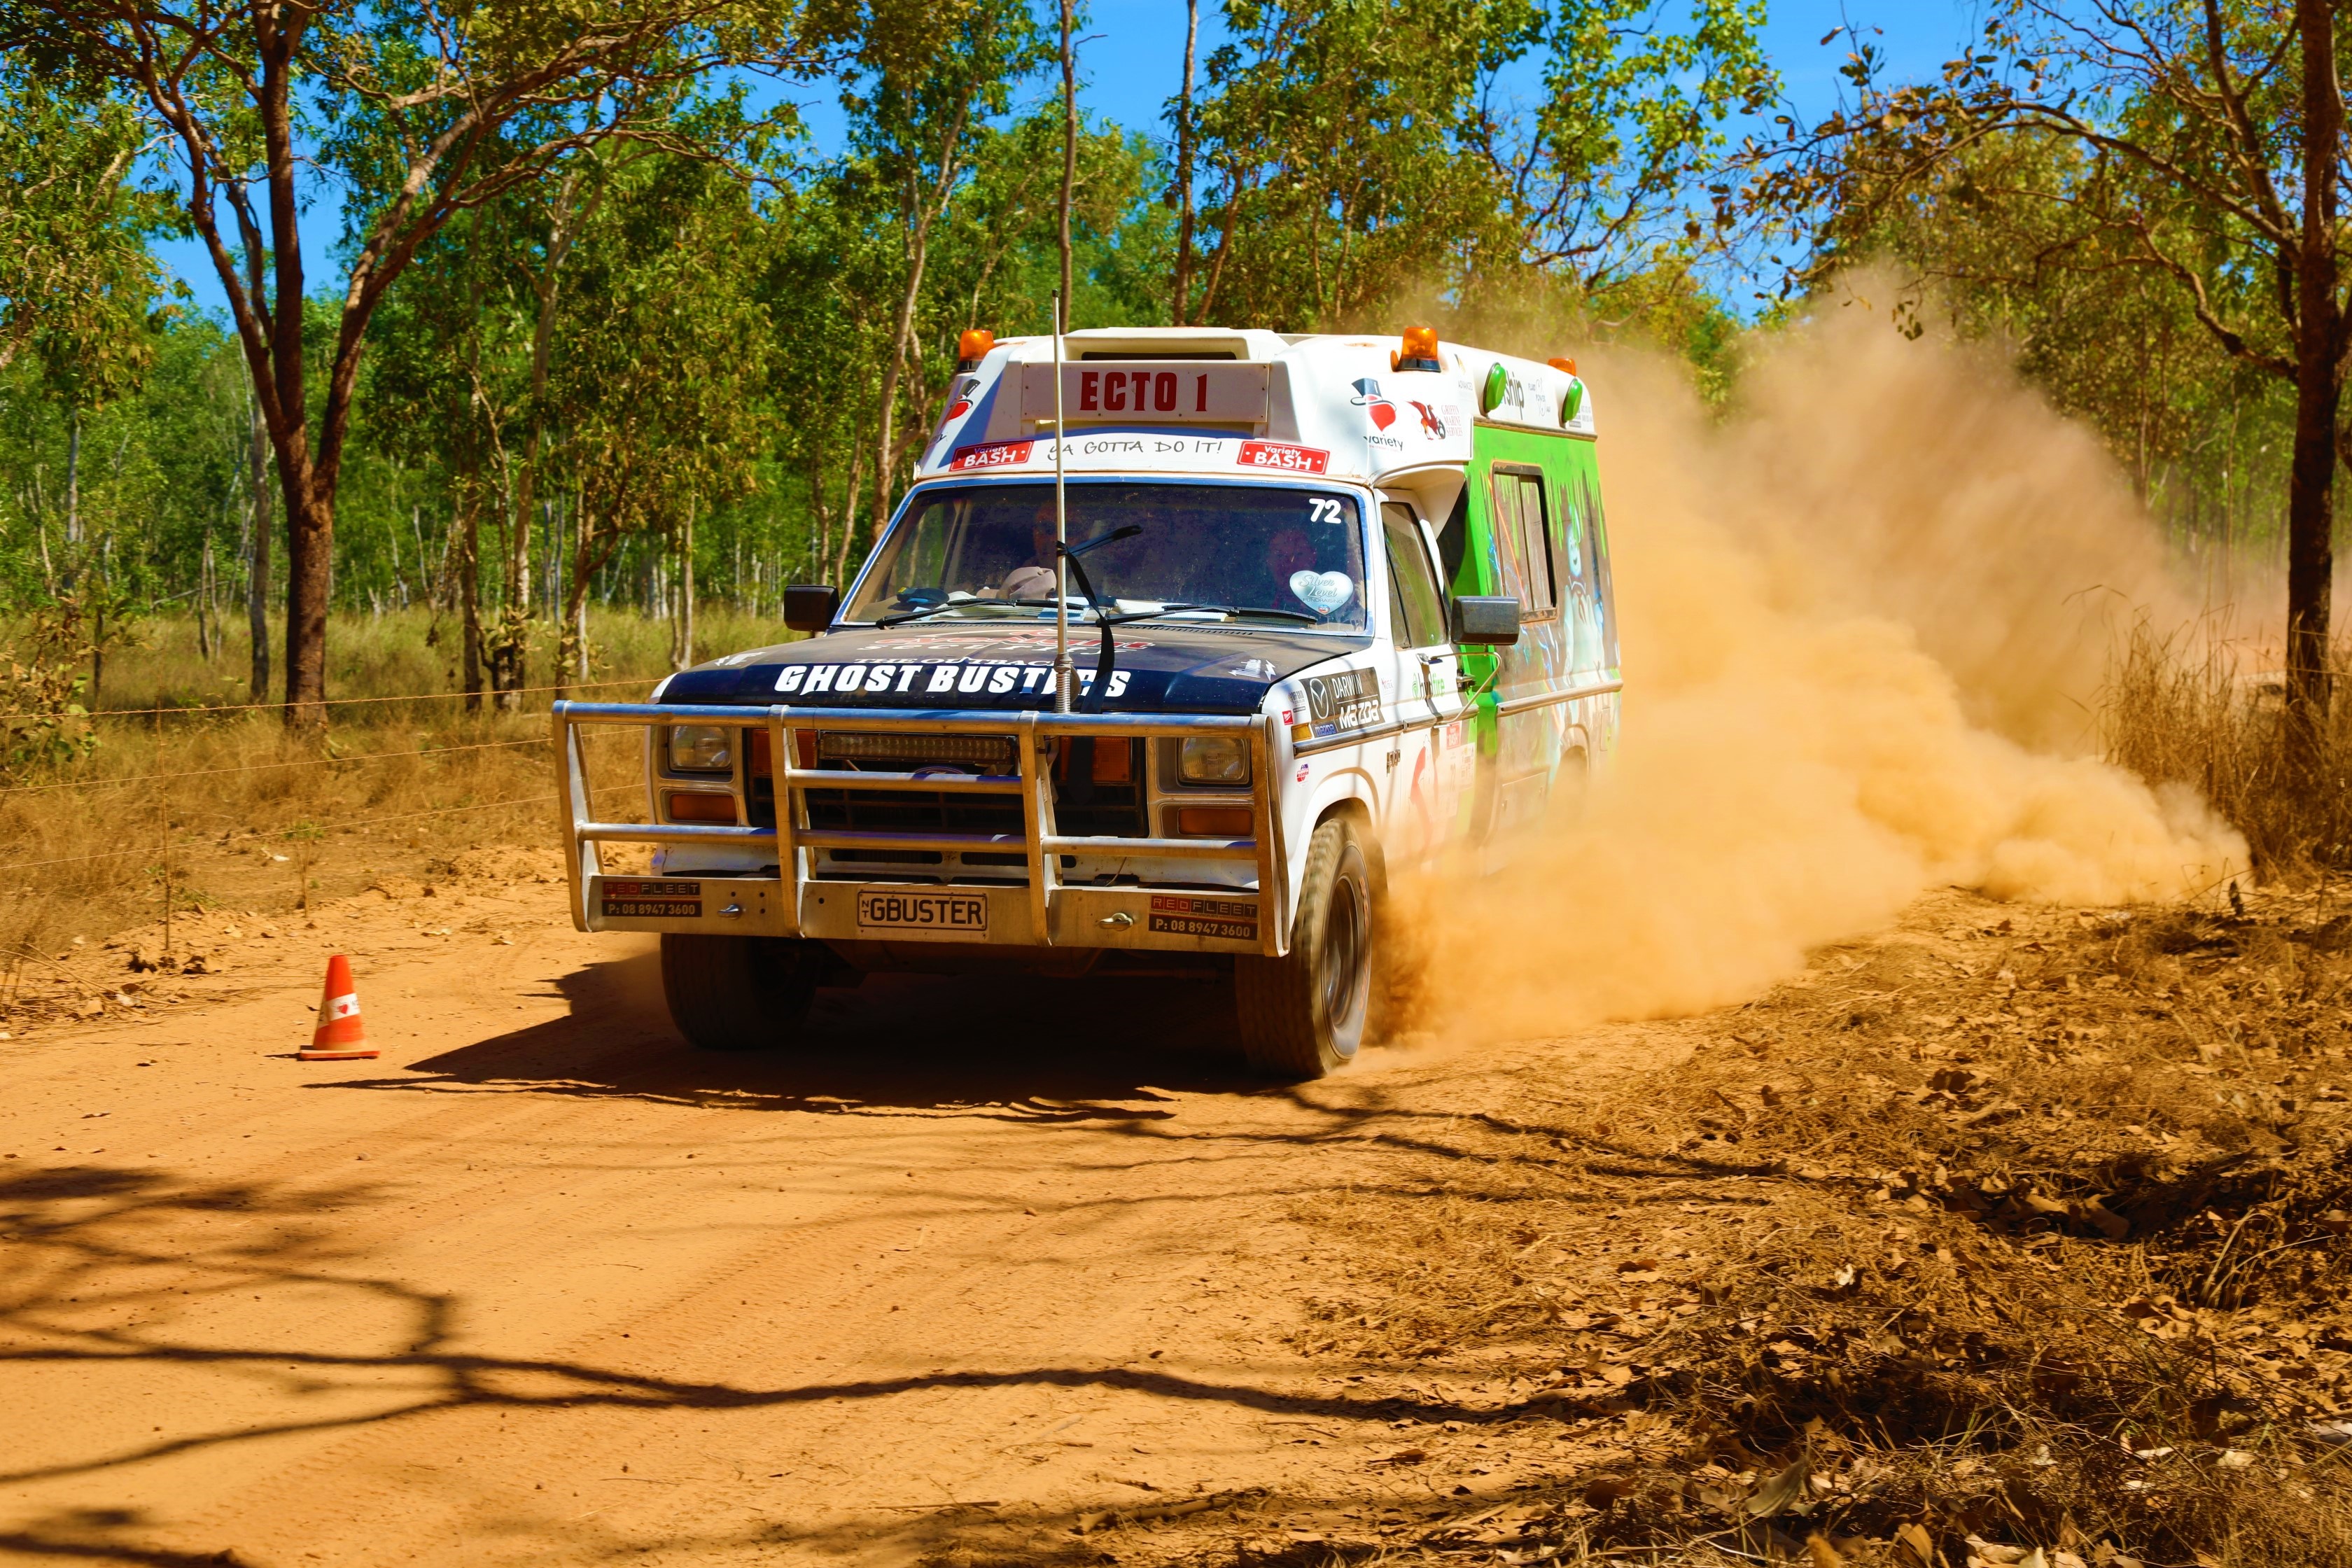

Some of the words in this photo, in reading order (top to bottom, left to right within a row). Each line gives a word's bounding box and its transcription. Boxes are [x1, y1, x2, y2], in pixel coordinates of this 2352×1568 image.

[1079, 372, 1177, 412] ECTO
[1196, 373, 1208, 412] 1
[1504, 370, 1525, 421] ship
[1441, 405, 1460, 415] GRIFFIN
[1443, 416, 1462, 426] MARINE
[1446, 426, 1464, 437] SERVICES
[974, 445, 1008, 455] Variety
[1084, 440, 1144, 454] GOTTA
[1154, 440, 1184, 452] DO
[1195, 440, 1223, 454] IT!
[1363, 434, 1404, 451] variety
[1264, 445, 1301, 457] Variety
[964, 450, 1017, 468] BASH
[1254, 451, 1312, 470] BASH
[1309, 498, 1342, 524] 72
[1298, 574, 1335, 587] Silver
[1307, 586, 1338, 598] Level
[920, 657, 1065, 667] OUTBAC
[774, 664, 923, 696] GHOST
[1331, 673, 1364, 699] DARWIN
[605, 884, 699, 893] REDFLEET
[608, 904, 620, 914] P:
[622, 904, 635, 915] 08
[638, 904, 665, 915] 8947
[668, 904, 696, 915] 3600
[870, 897, 983, 925] GBUSTER
[1153, 898, 1255, 915] REDFLEET
[1156, 918, 1168, 930] P:
[1171, 920, 1186, 931] 08
[1188, 921, 1219, 934] 8947
[1221, 925, 1250, 937] 3600
